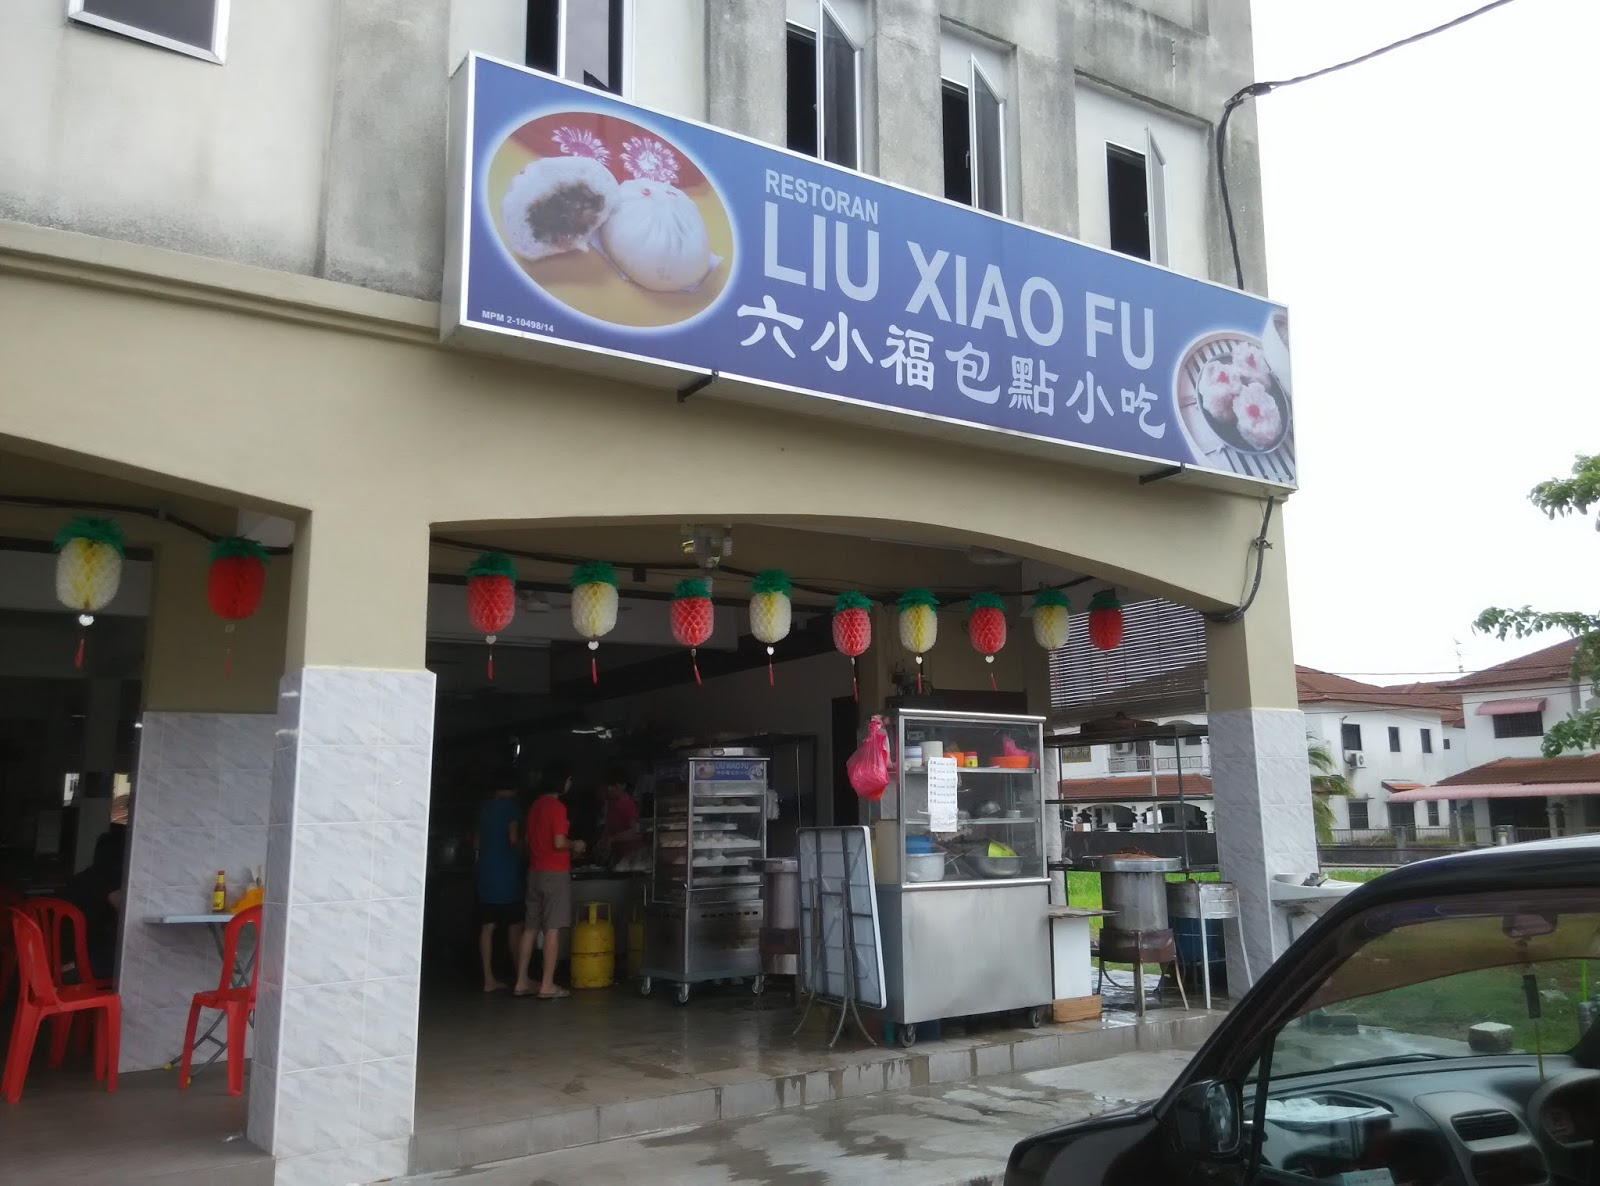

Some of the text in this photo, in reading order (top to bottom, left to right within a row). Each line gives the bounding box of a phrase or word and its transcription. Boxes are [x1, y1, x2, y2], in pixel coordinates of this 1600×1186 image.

[765, 169, 878, 225] RESTORAN
[481, 310, 554, 332] MPM 2-10498/14
[764, 202, 1155, 370] LIU XIAO FU
[736, 295, 1166, 439] 六小福包點小吃
